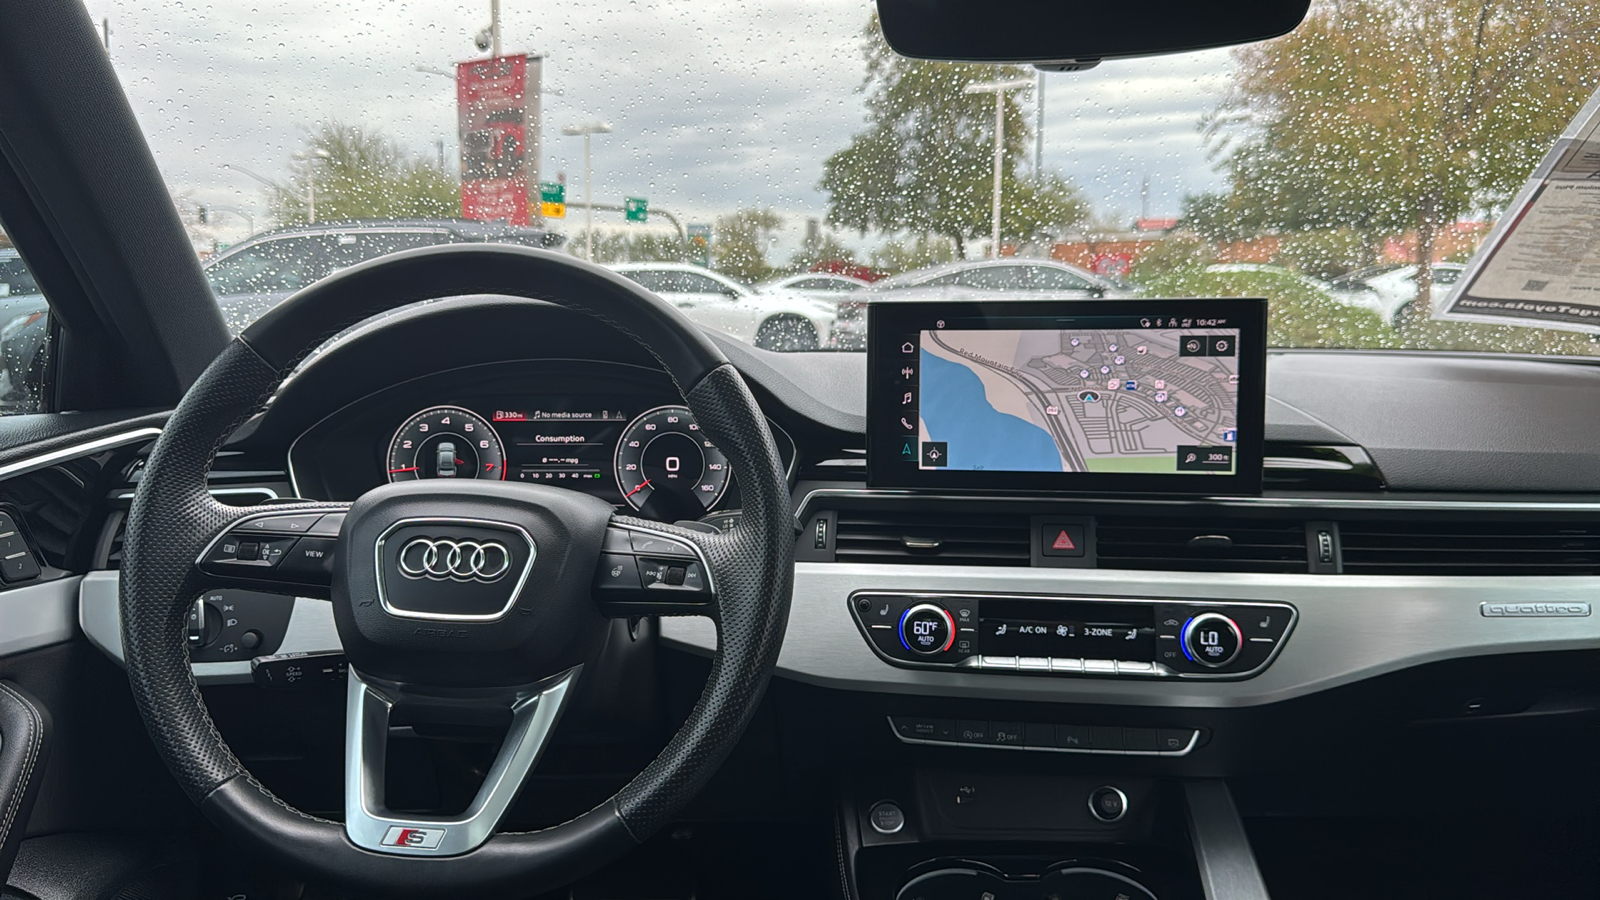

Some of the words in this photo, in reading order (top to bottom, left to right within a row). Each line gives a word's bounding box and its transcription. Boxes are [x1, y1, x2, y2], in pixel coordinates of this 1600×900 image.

[959, 347, 974, 359] Red
[974, 353, 1010, 372] Mountain
[541, 411, 550, 419] No
[551, 411, 570, 419] media
[440, 416, 451, 425] 4
[419, 423, 429, 432] 3
[464, 423, 475, 432] 5
[535, 434, 586, 443] Consumption
[403, 440, 413, 449] 2
[480, 440, 490, 449] 6
[1208, 453, 1223, 461] 300
[485, 463, 494, 472] 7
[625, 463, 637, 471] 20
[666, 457, 680, 472] 0
[709, 463, 722, 471] 140
[305, 550, 324, 558] VIEW
[1489, 604, 1583, 616] quattro
[1019, 625, 1033, 633] A/C
[1035, 626, 1047, 634] ON
[1084, 627, 1113, 636] 3-ZONE
[917, 635, 935, 643] AUTO
[405, 830, 427, 845] S
